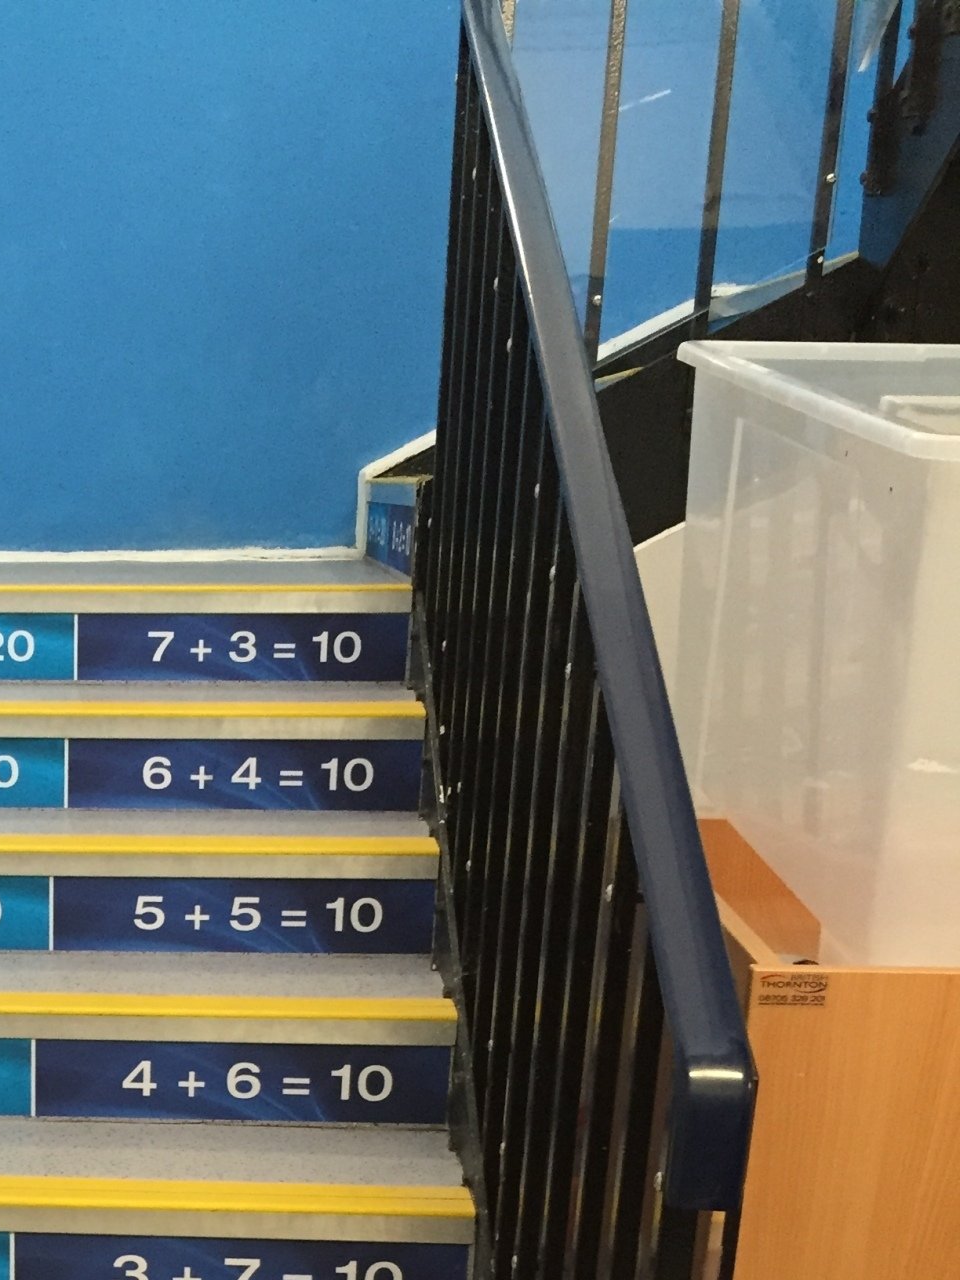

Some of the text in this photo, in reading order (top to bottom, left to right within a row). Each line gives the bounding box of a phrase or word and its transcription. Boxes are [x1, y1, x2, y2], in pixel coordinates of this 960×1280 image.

[147, 630, 362, 664] 7 + 3 = 10
[142, 755, 374, 792] 6 + 4 = 10
[133, 895, 383, 933] 5 + 5 = 10
[759, 981, 829, 989] THORNTON
[122, 1060, 393, 1102] 4 + 6 = 10
